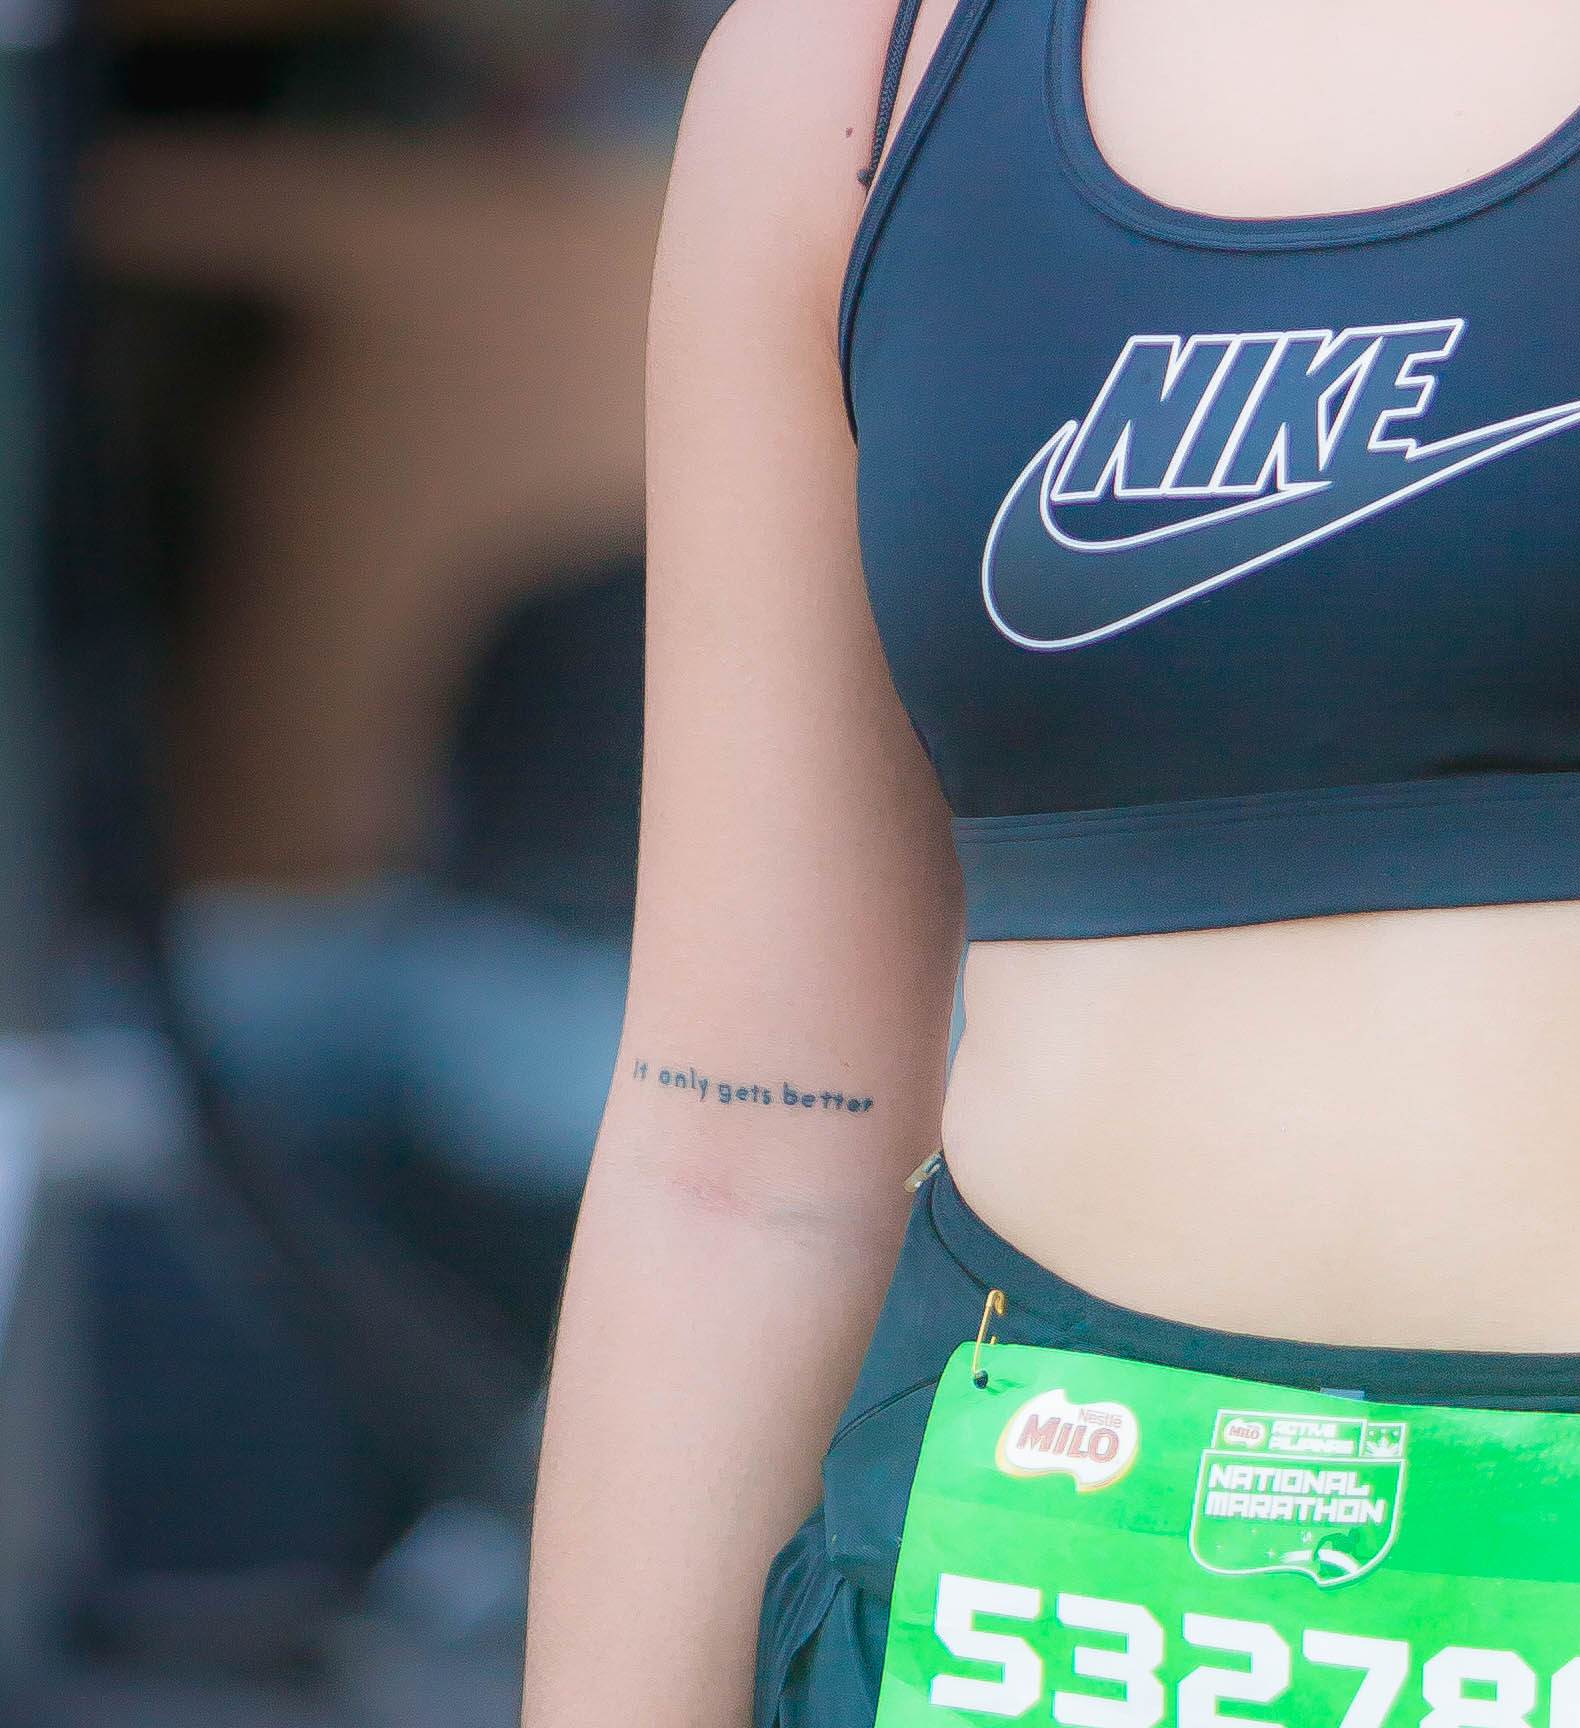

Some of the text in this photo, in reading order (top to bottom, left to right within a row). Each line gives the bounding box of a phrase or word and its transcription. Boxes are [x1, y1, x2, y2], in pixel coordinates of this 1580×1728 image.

[1050, 318, 1465, 502] NIKE
[659, 1067, 709, 1101] only
[718, 1082, 771, 1105] gets
[783, 1081, 873, 1112] better
[1016, 1414, 1119, 1463] MILO
[1229, 1425, 1259, 1440] MILO
[1208, 1463, 1371, 1496] NATIONAL
[1205, 1491, 1386, 1524] MARATHON
